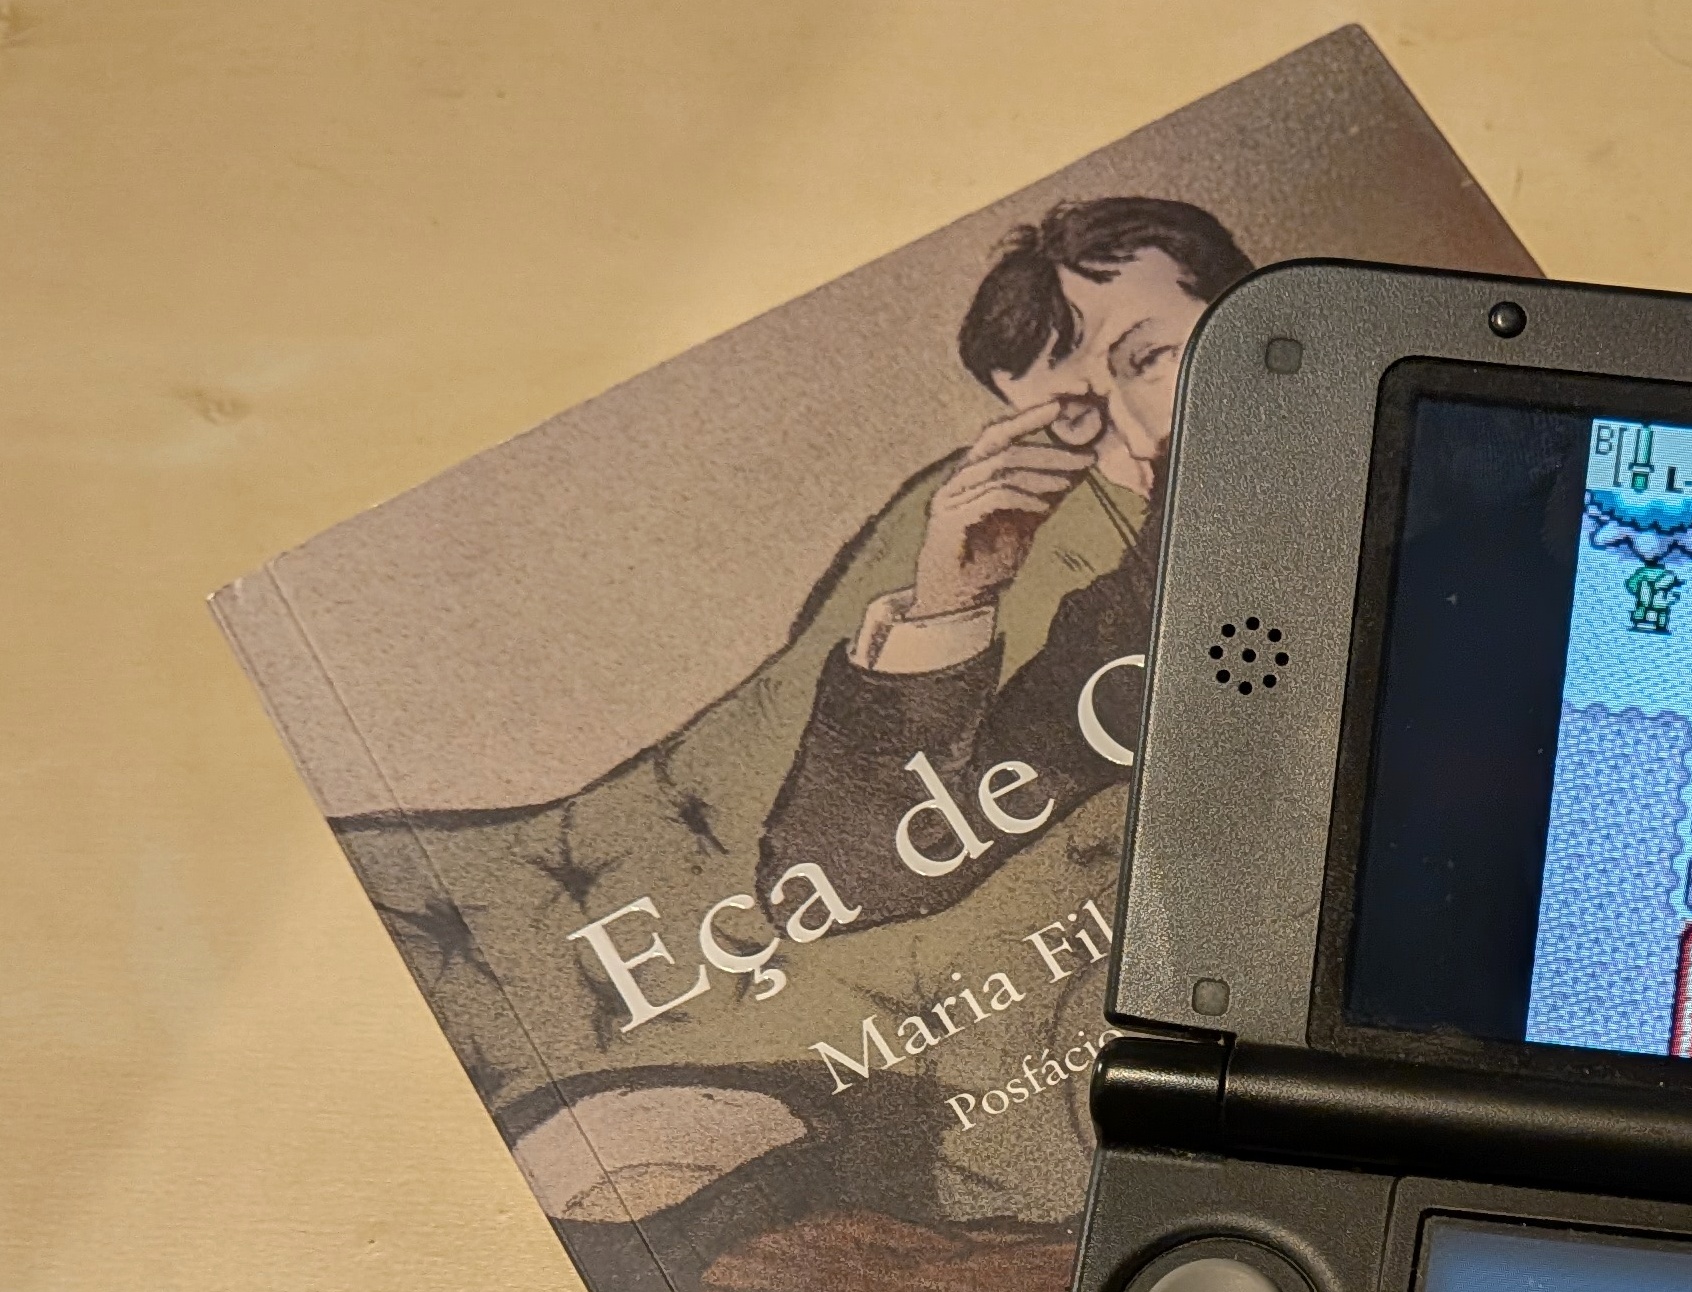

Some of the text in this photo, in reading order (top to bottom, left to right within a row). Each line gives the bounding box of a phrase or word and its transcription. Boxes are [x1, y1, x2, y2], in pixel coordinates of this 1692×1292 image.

[1596, 425, 1614, 455] B
[567, 751, 1055, 1034] Eça de
[809, 972, 1027, 1095] Maria
